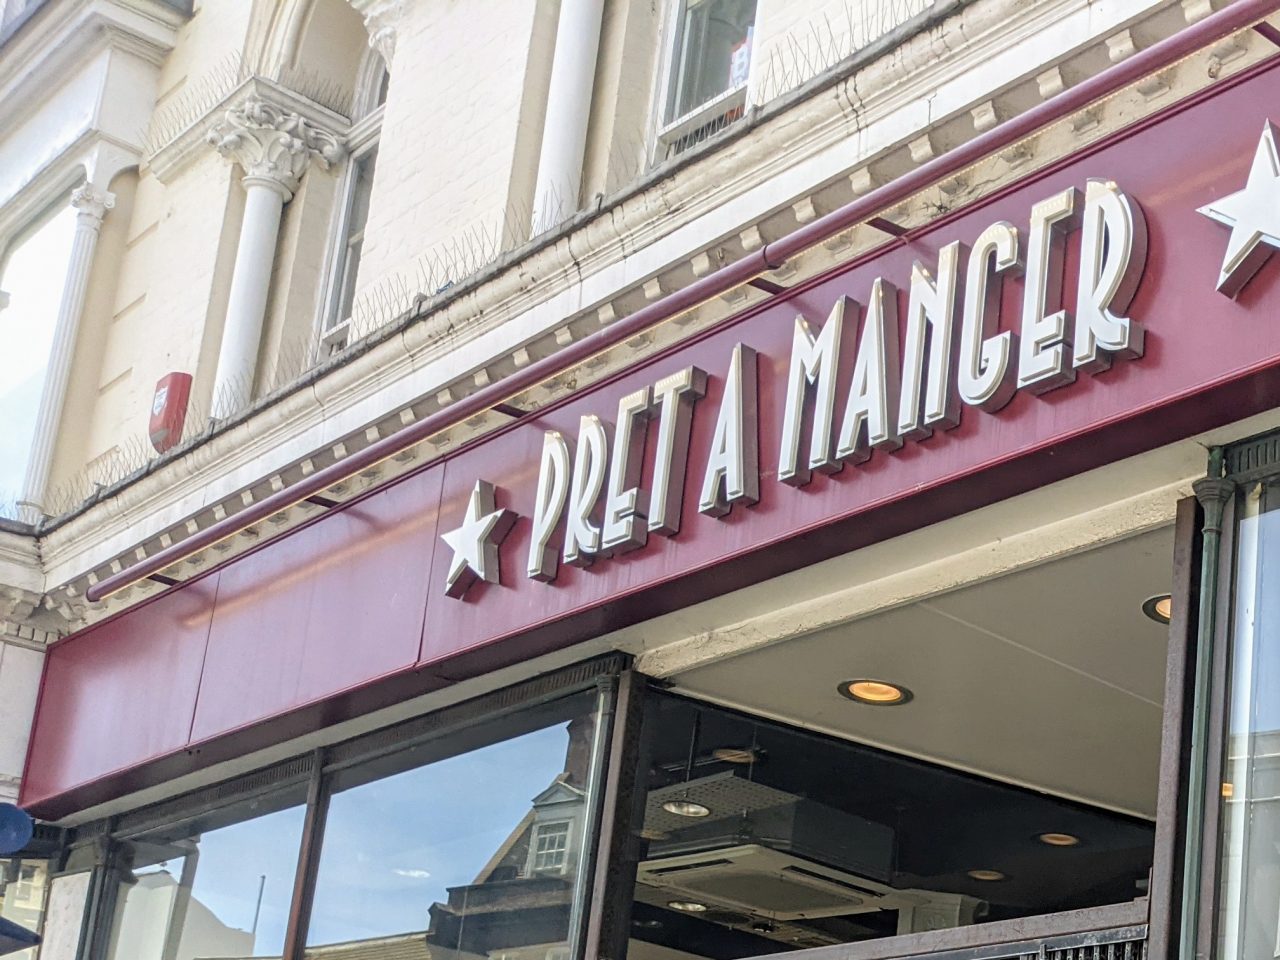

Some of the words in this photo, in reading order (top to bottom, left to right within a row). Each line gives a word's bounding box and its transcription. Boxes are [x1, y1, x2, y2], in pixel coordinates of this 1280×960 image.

[527, 365, 707, 581] PRET
[698, 342, 760, 518] A
[777, 176, 1149, 489] MANGER
